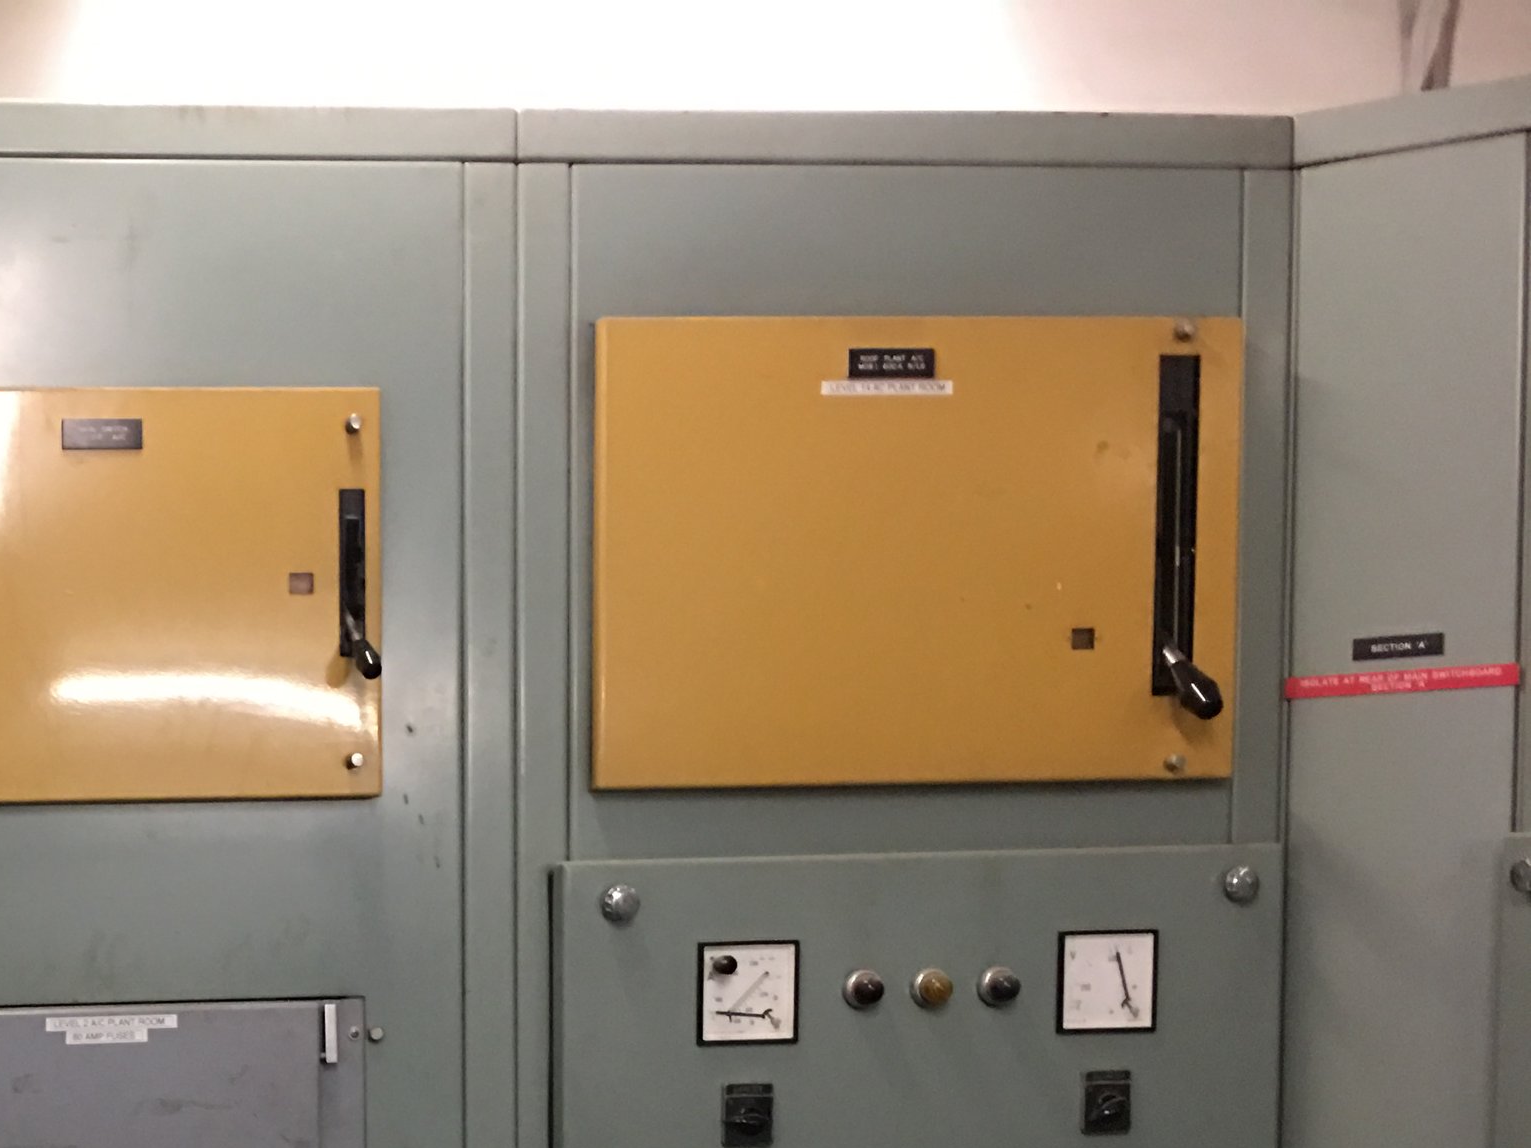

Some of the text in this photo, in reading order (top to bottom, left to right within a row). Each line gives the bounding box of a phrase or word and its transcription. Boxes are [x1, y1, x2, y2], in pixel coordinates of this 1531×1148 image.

[1371, 641, 1412, 653] SECTION
[1299, 676, 1339, 688] ISOLATE
[1343, 676, 1355, 685] AT
[1359, 674, 1383, 684] REAR
[1404, 671, 1427, 681] MAIN
[1432, 666, 1502, 680] SWITCHBOARD
[1370, 681, 1412, 691] SECTION
[53, 1018, 80, 1028] LEVEL
[107, 1017, 135, 1026] PLANT
[138, 1016, 165, 1025] ROOM
